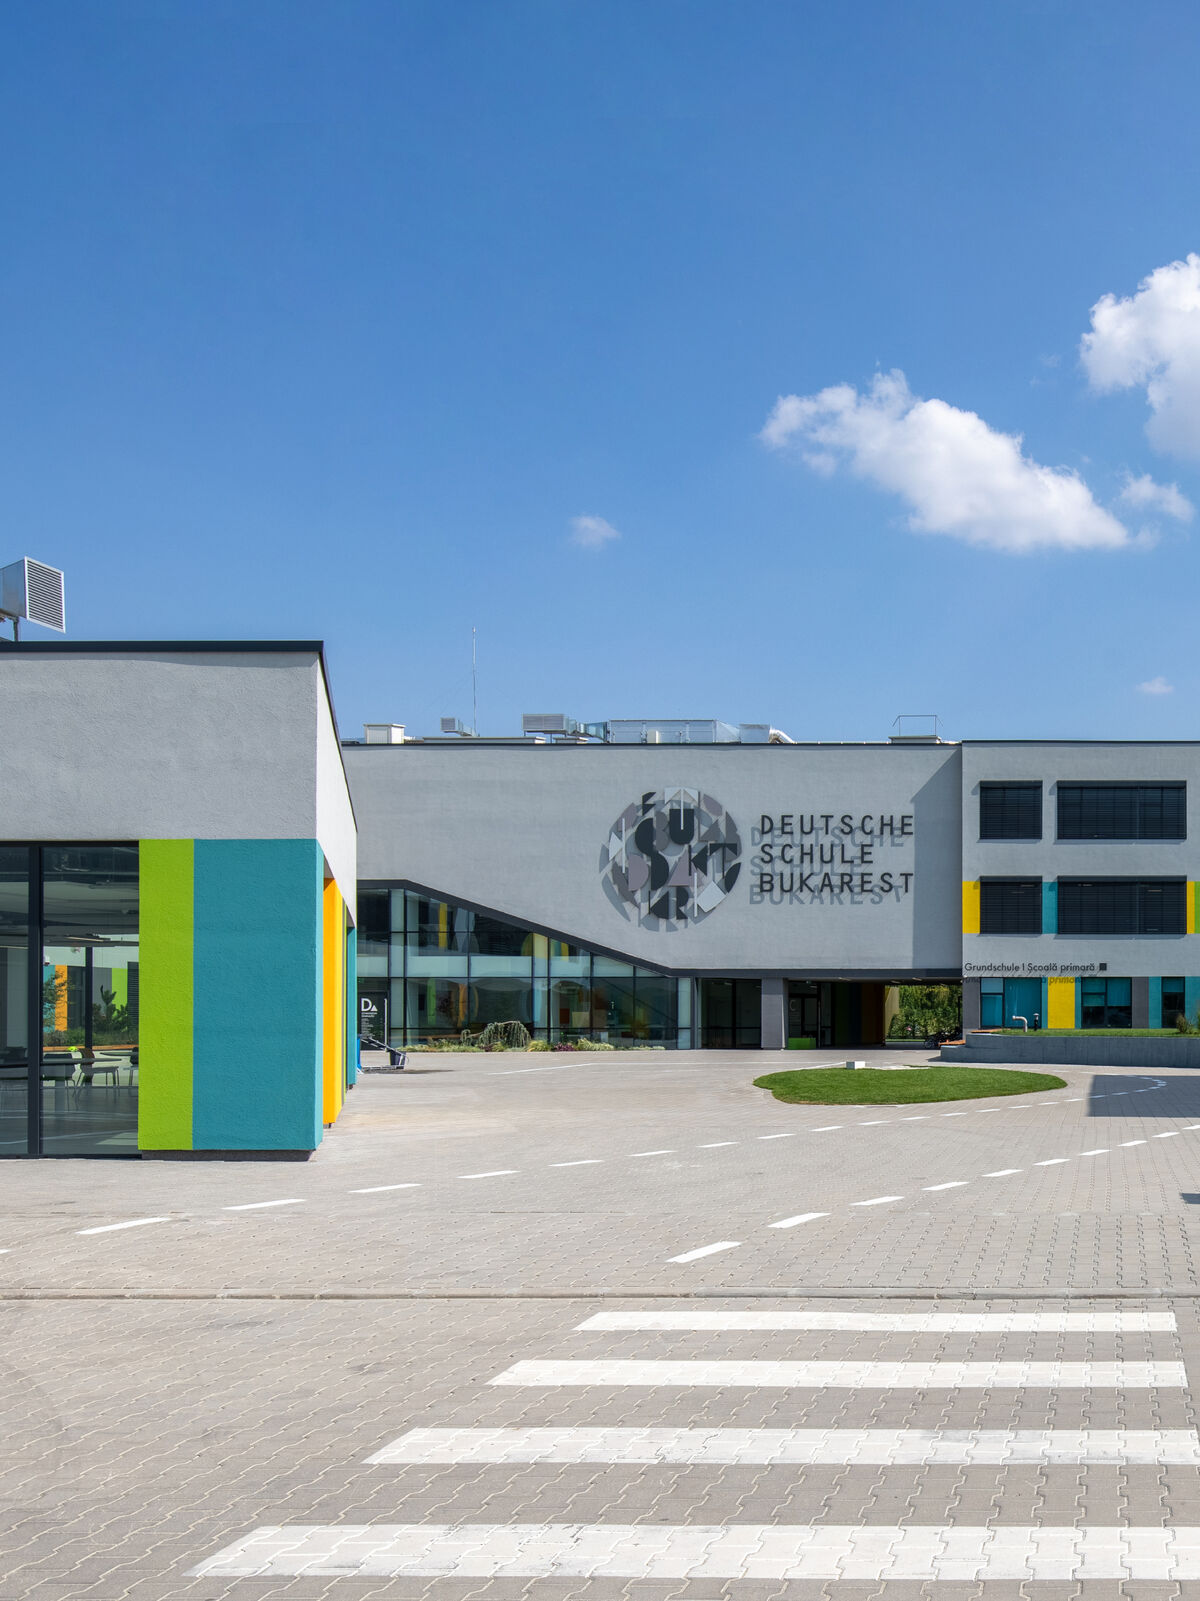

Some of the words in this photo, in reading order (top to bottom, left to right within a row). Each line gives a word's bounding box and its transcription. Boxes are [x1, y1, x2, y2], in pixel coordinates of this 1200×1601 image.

[760, 814, 914, 836] DEUTSCHE
[760, 843, 874, 864] SCHULE
[759, 872, 914, 893] BUKAREST
[964, 962, 1020, 972] Grundschule
[1060, 963, 1095, 974] primară
[361, 998, 372, 1011] D
